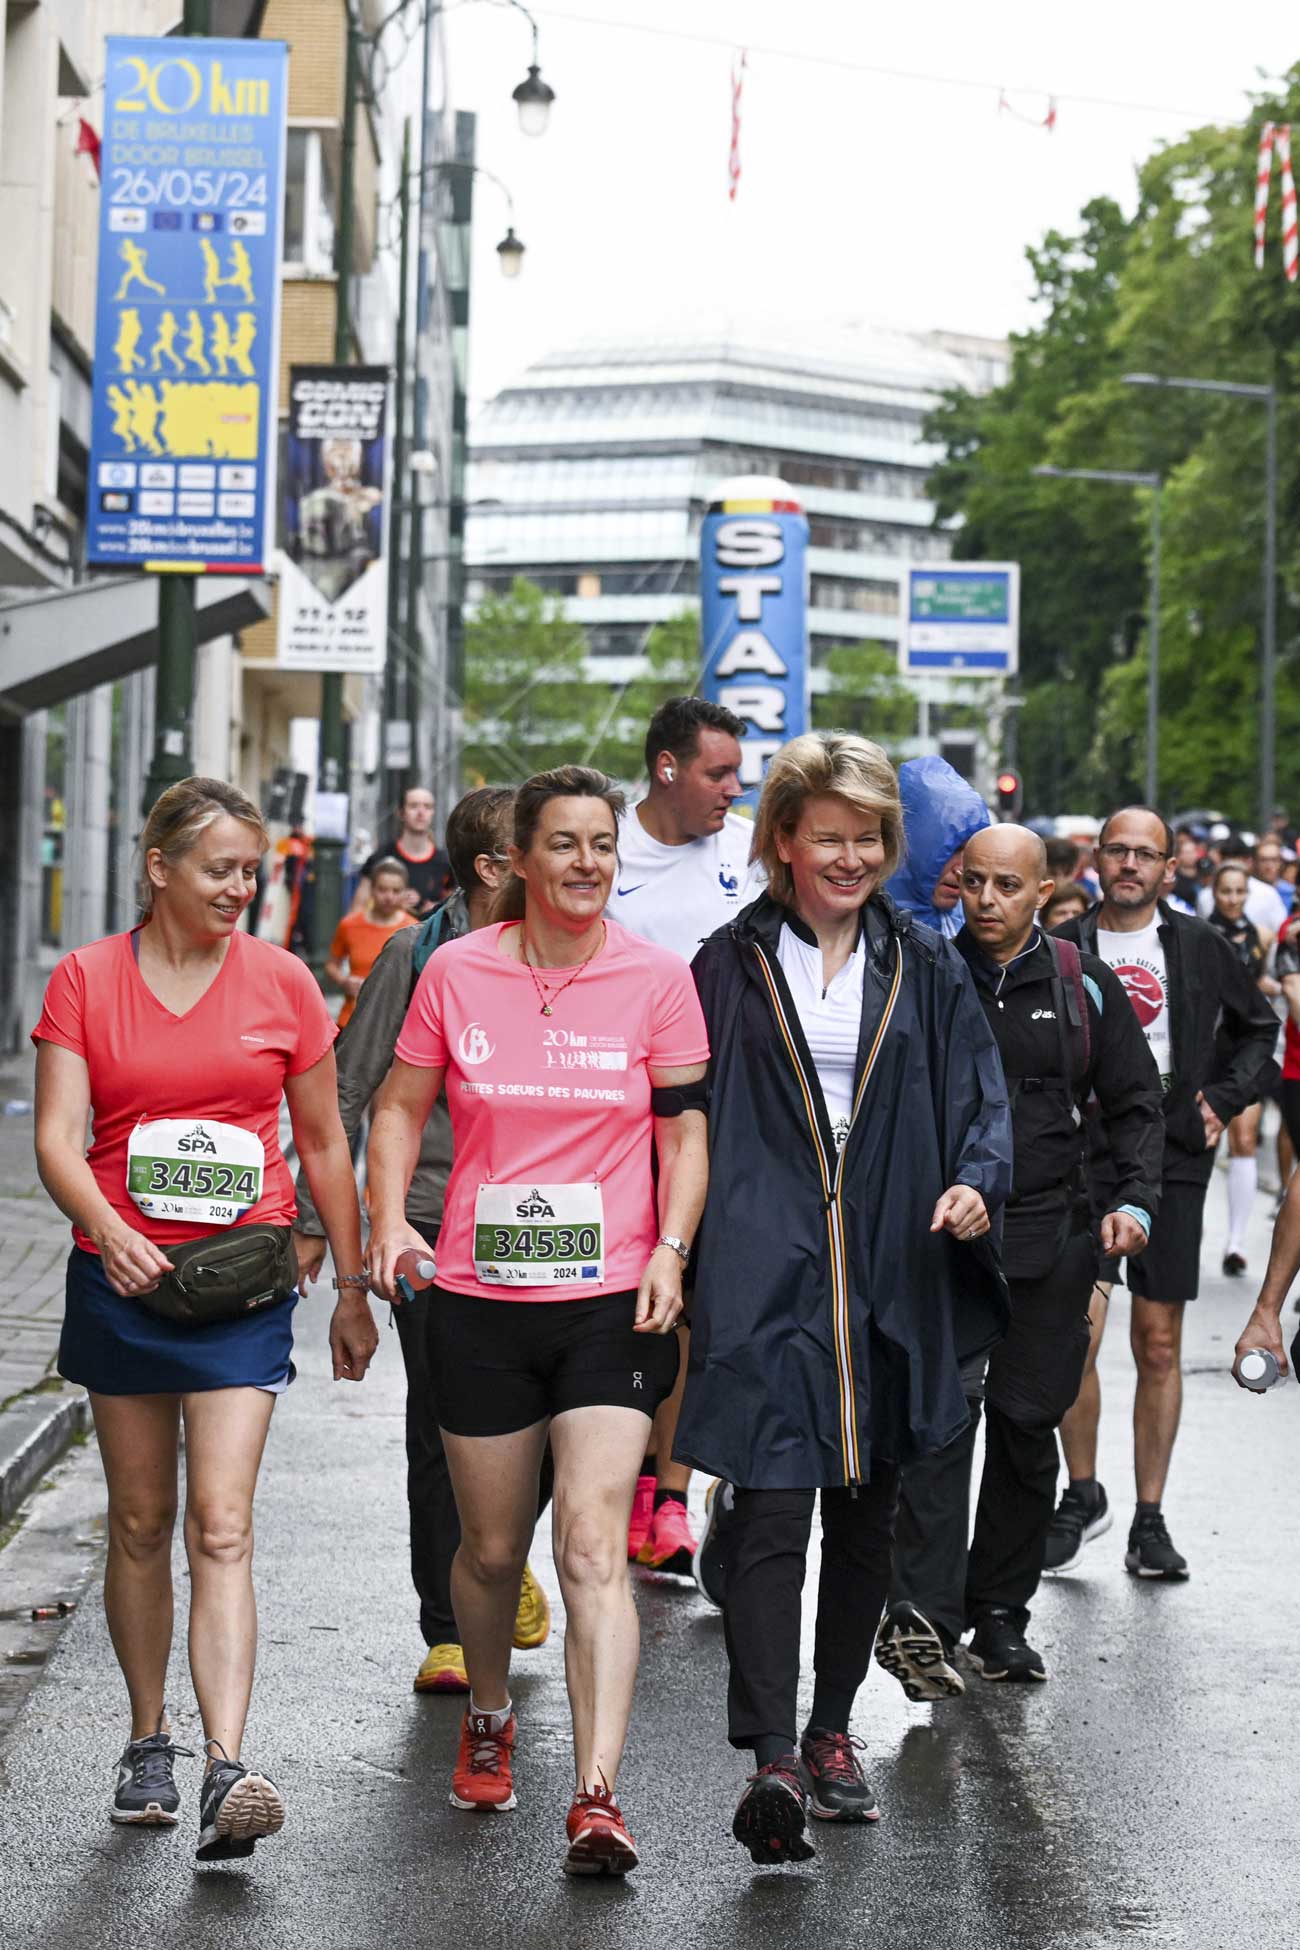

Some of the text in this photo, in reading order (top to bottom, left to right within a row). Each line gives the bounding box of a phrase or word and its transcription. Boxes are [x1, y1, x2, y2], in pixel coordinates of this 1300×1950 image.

[113, 56, 270, 116] 20 km
[112, 120, 254, 144] DE BRUXELLES
[111, 144, 267, 168] DOOR BRUSSEL
[111, 167, 267, 207] 26/05/24
[298, 402, 381, 427] CON
[714, 519, 788, 786] START
[543, 1029, 588, 1047] 20 km
[460, 1081, 625, 1101] PETITES SOEURS DES PAUVRES
[177, 1138, 217, 1155] SPA
[149, 1161, 256, 1200] 34524
[209, 1205, 233, 1218] 2024
[516, 1204, 556, 1218] SPA
[493, 1227, 598, 1259] 34530
[553, 1267, 577, 1279] 2024
